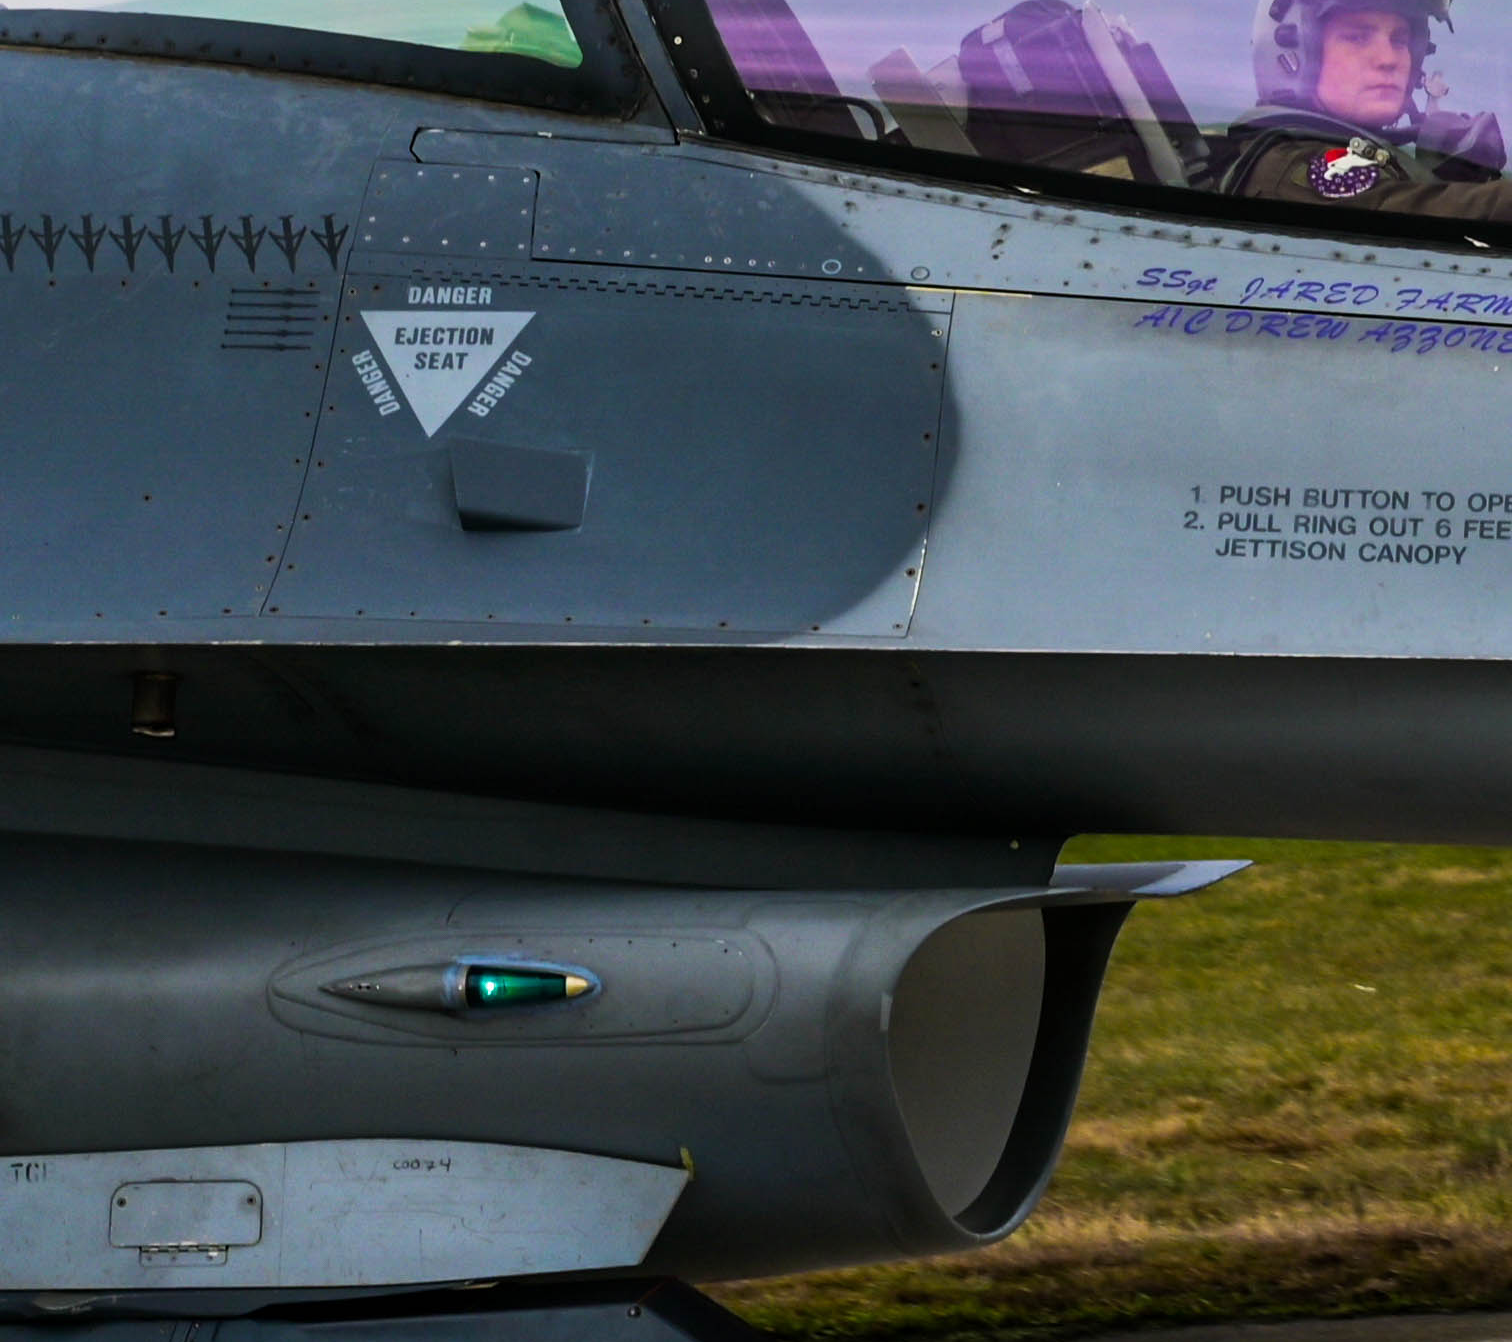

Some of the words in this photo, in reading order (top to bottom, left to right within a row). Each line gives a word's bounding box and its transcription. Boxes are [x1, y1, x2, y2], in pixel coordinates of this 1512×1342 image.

[408, 286, 493, 305] DANGER
[1240, 277, 1379, 305] JARED
[394, 327, 495, 346] EJECTION
[1225, 311, 1349, 339] DREW
[414, 352, 469, 370] SEAT
[351, 349, 401, 417] DANGER
[467, 350, 533, 418] DANGER
[1219, 485, 1291, 507] PUSH
[1303, 488, 1409, 510] BUTTON
[1422, 491, 1455, 512] TO
[1183, 510, 1205, 530] 2.
[1217, 512, 1282, 533] PULL
[1293, 514, 1357, 536] RING
[1369, 517, 1424, 537] OUT
[1435, 518, 1452, 539] 6
[1215, 538, 1346, 561] JETTISON
[1358, 542, 1467, 565] CANOPY
